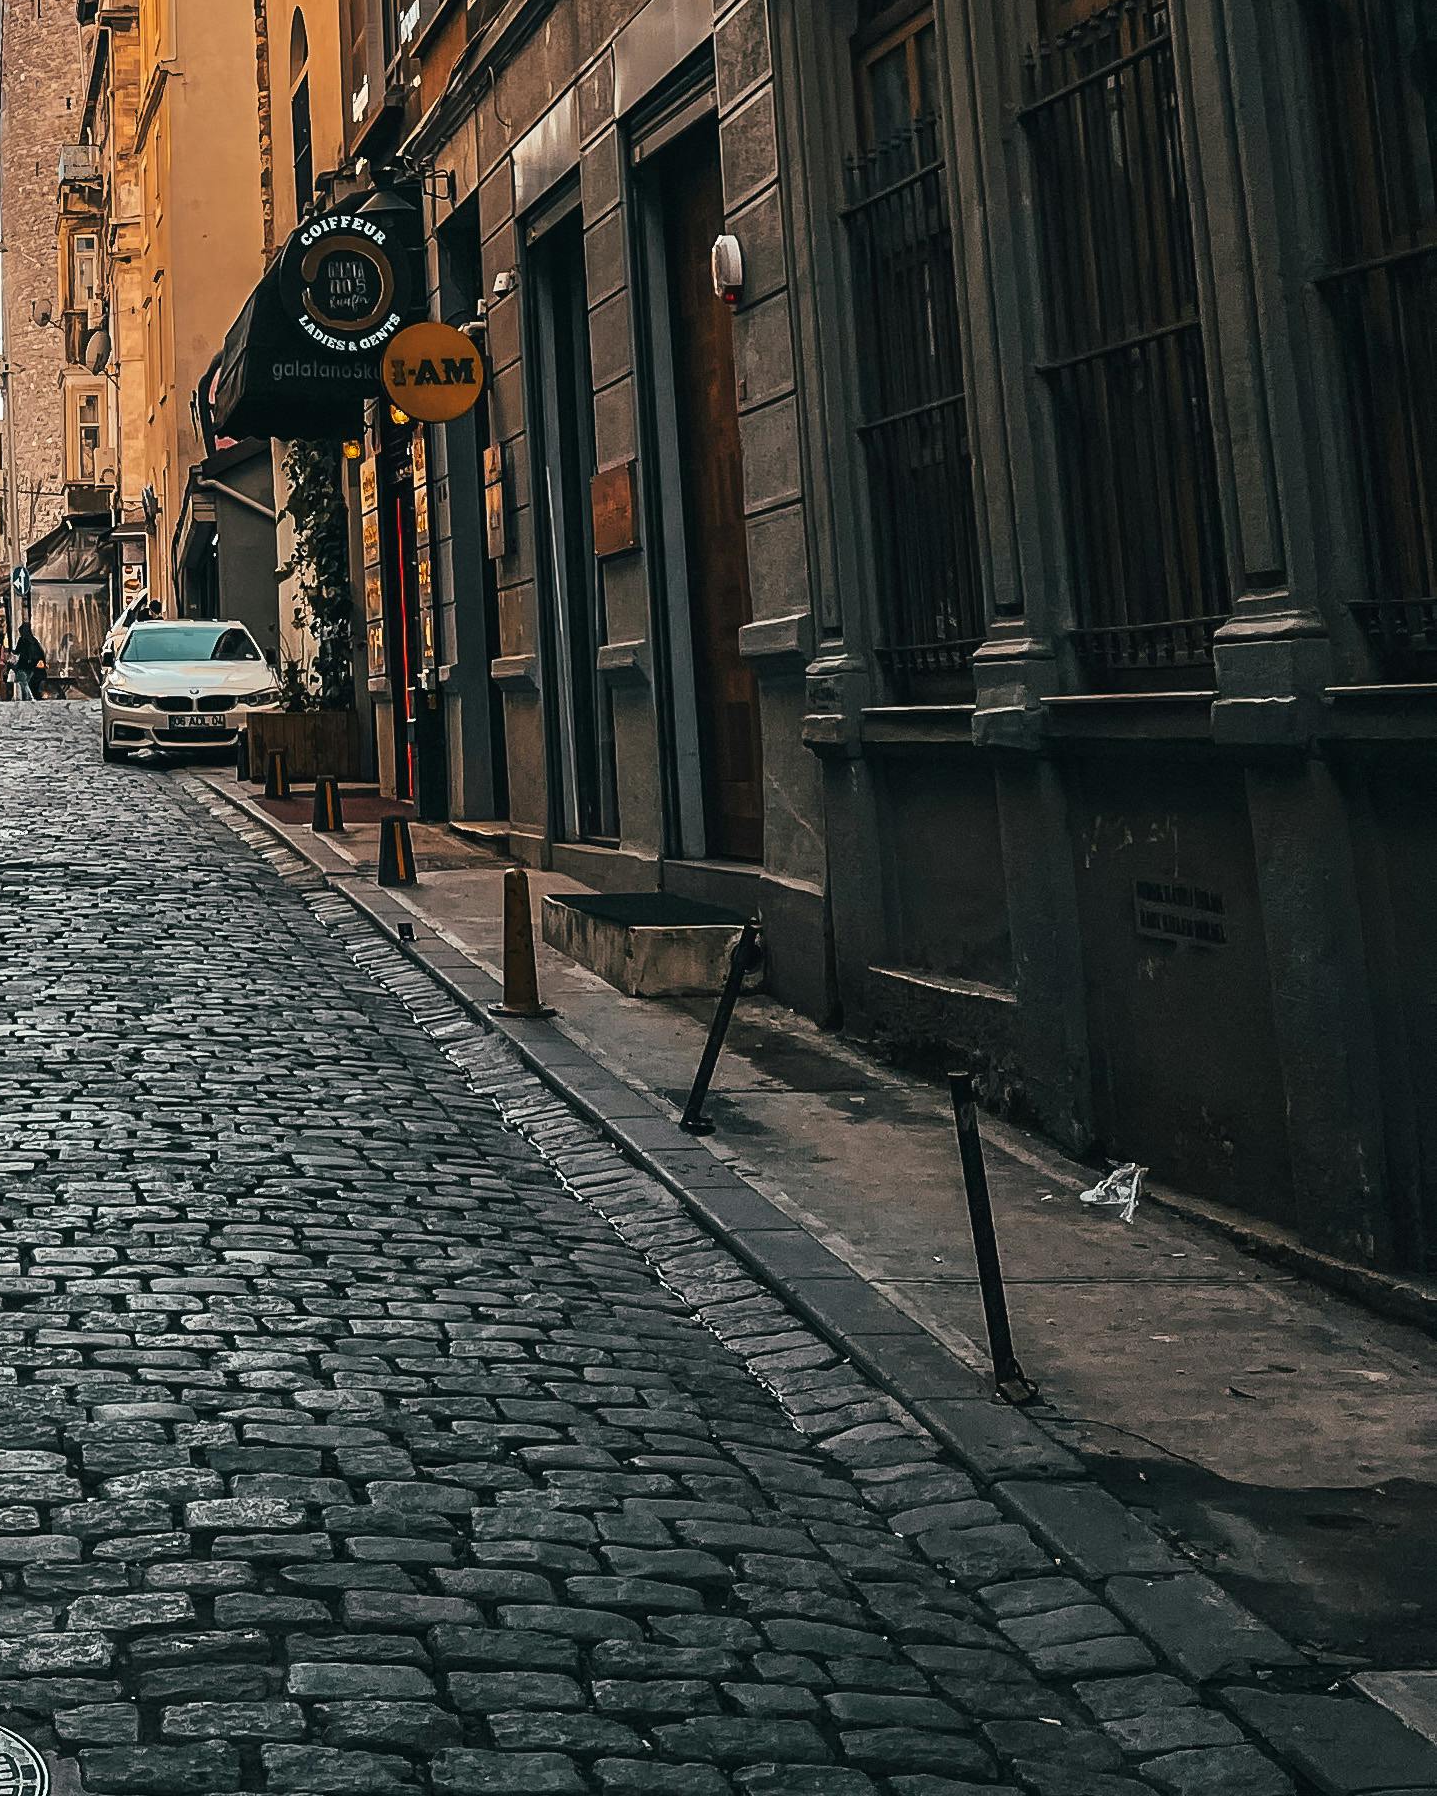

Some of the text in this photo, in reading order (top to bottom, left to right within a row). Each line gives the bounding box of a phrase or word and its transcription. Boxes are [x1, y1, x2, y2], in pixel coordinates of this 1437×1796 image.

[300, 215, 387, 246] COIFFEUR
[298, 313, 401, 352] LADIES & GENTS
[391, 357, 477, 387] I-AM
